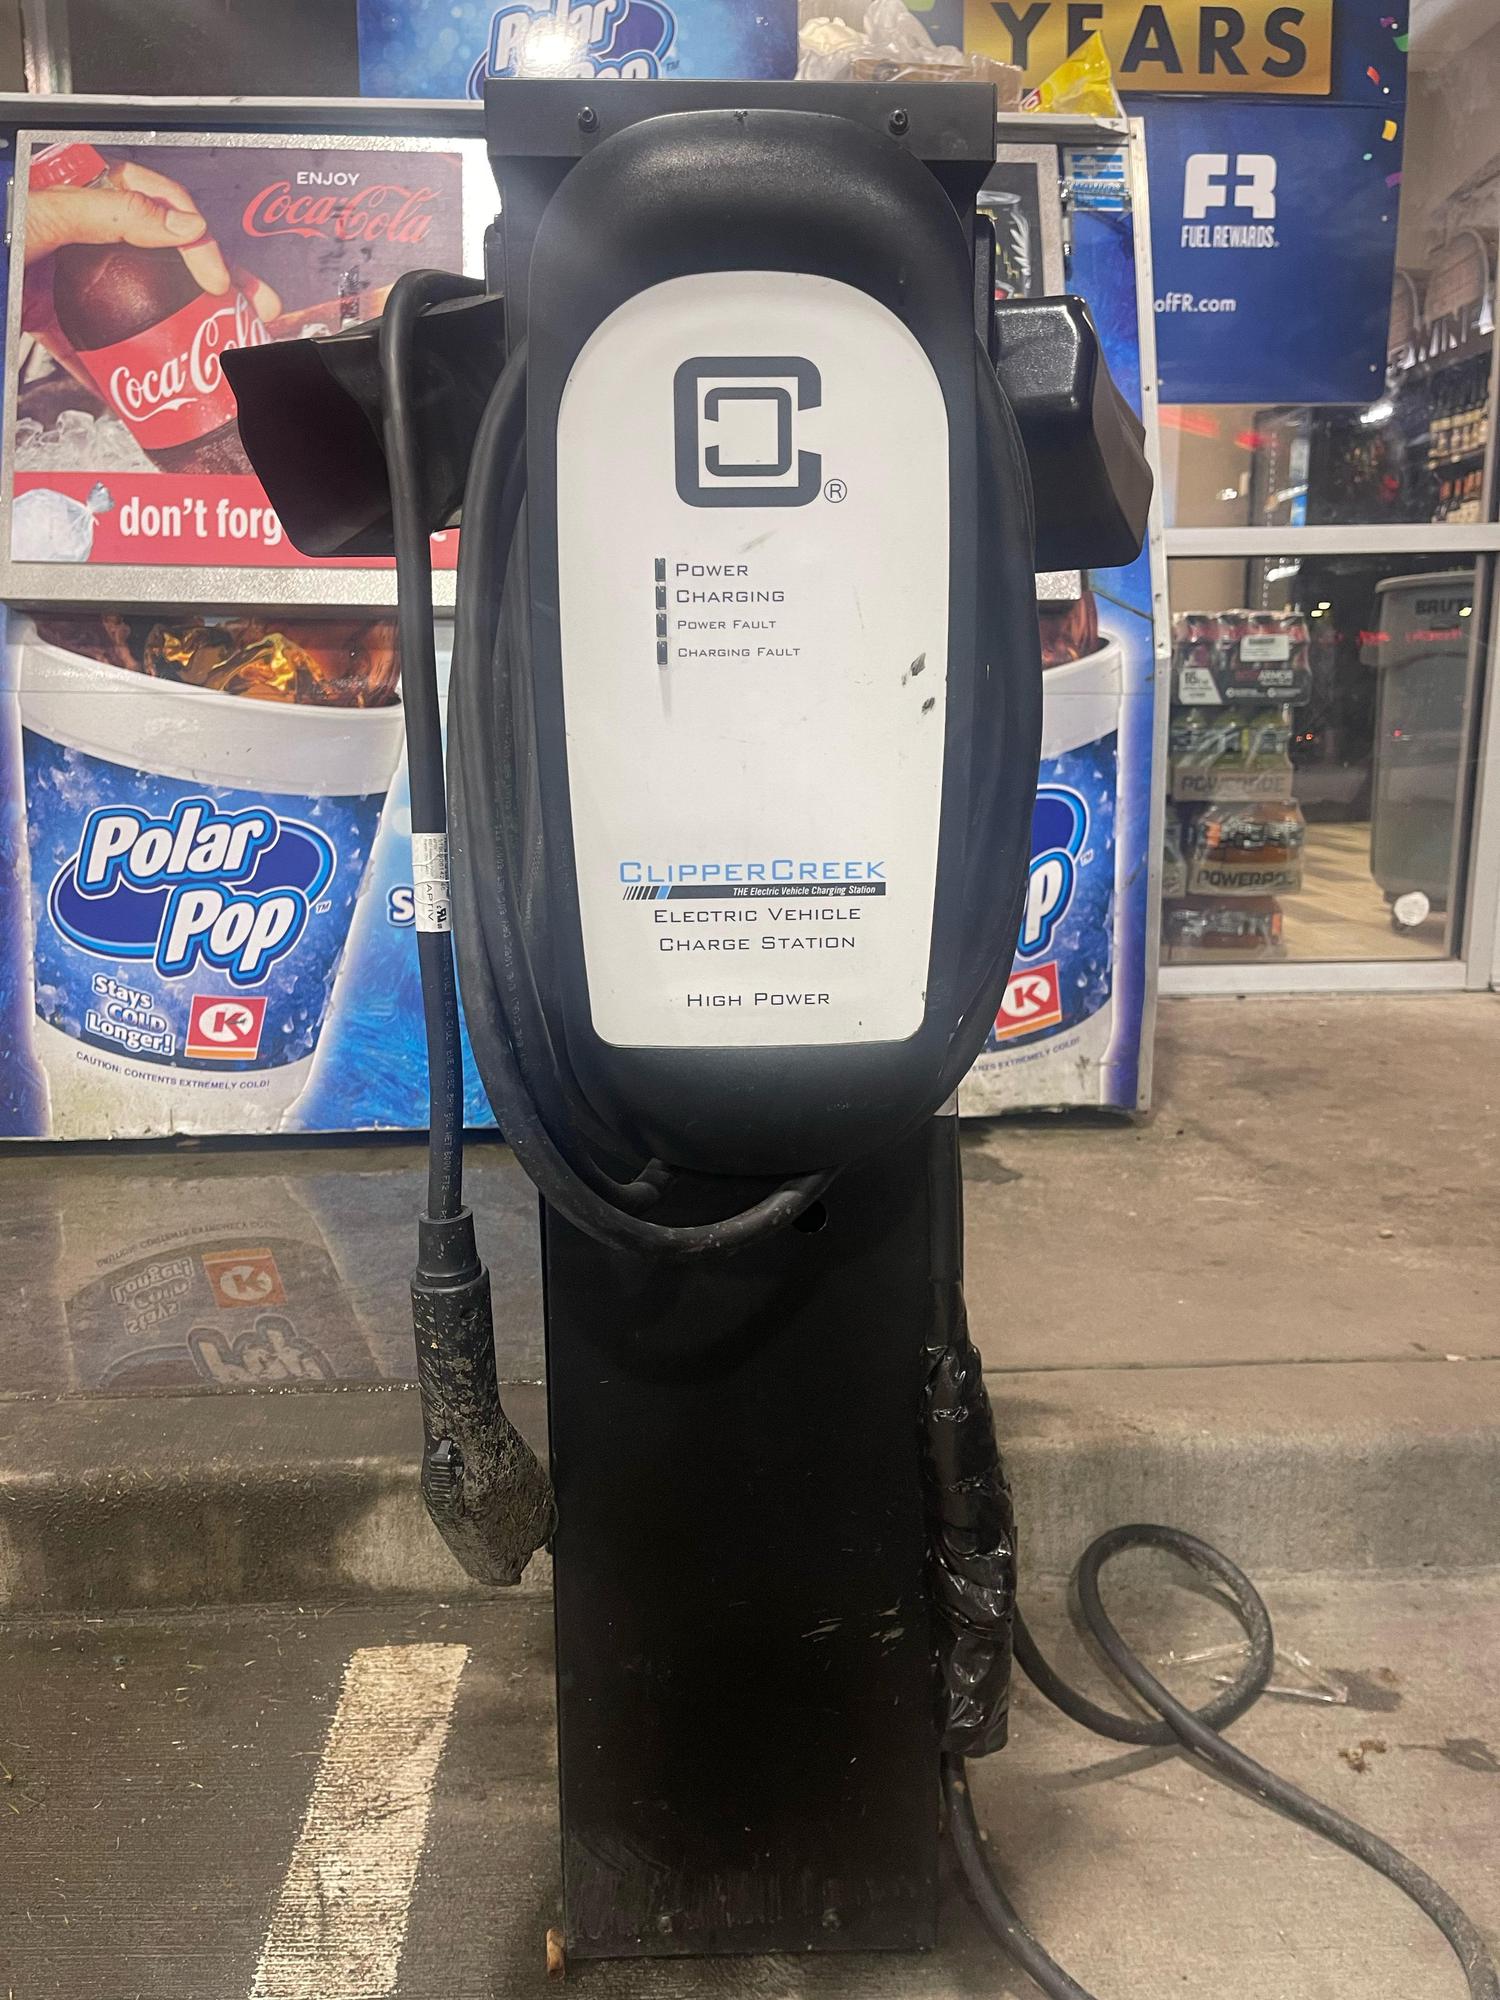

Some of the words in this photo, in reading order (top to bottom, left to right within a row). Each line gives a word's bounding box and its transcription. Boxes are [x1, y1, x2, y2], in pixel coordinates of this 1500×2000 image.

[296, 171, 361, 186] ENJOY
[242, 181, 443, 244] Coca-Cola
[1181, 225, 1210, 248] FUEL
[1153, 291, 1237, 313] ofFR.com
[676, 563, 748, 577] POWER
[677, 589, 785, 603] CHARGING
[678, 620, 726, 630] POWER
[733, 619, 777, 629] FAULT
[678, 648, 750, 658] CHARGING
[757, 647, 801, 657] FAULT
[87, 808, 264, 883] Polar
[733, 887, 748, 896] THE
[750, 886, 779, 896] Electric
[781, 886, 809, 895] Vehicle
[811, 885, 846, 897] Charging
[849, 885, 876, 894] Station
[654, 909, 757, 923] ELECTRIC
[768, 907, 861, 921] VEHICLE
[165, 889, 296, 973] Pop
[659, 938, 750, 952] CHARGE
[761, 936, 855, 950] STATION
[95, 976, 152, 1009] Stays
[687, 994, 742, 1007] HIGH
[754, 992, 830, 1006] POWER
[107, 1004, 166, 1033] COLD
[88, 1012, 173, 1054] Longer!
[124, 1068, 178, 1086] CONTENTS
[179, 1079, 237, 1090] EXTREMELY
